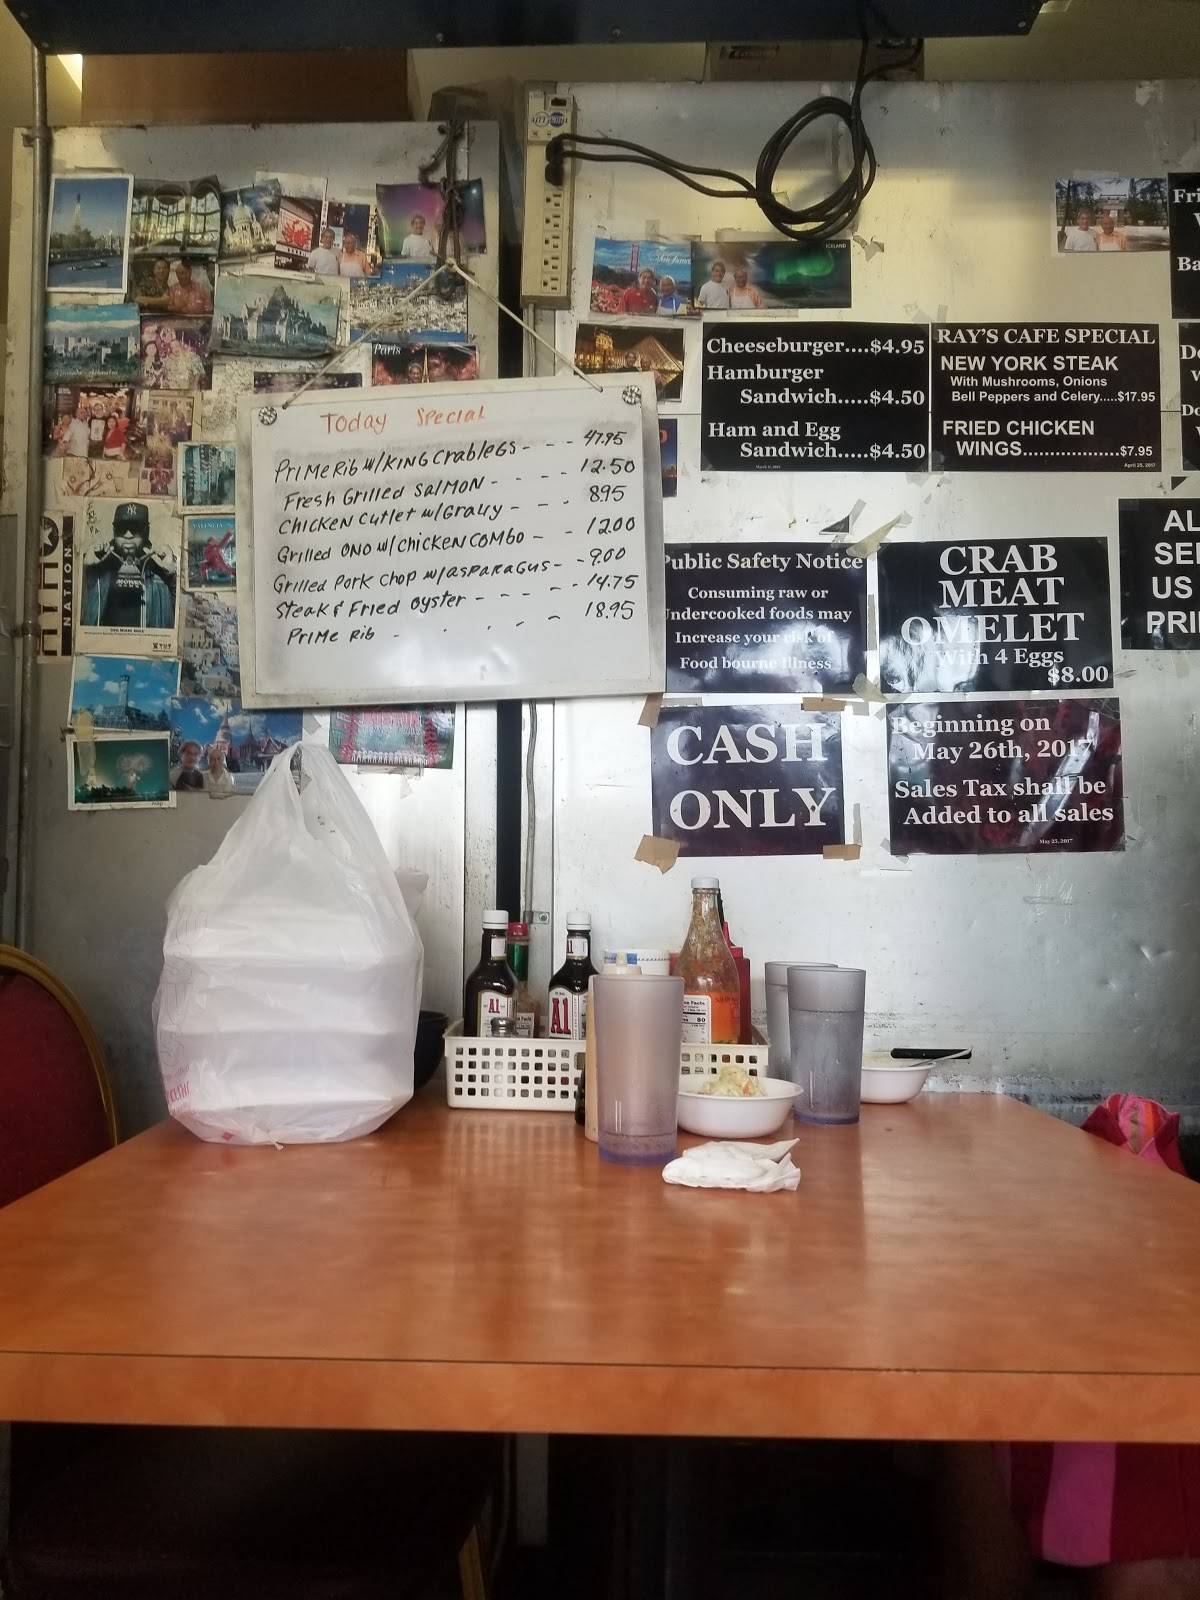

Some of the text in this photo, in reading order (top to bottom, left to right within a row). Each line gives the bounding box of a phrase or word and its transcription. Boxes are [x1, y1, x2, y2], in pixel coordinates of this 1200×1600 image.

[1003, 328, 1060, 344] CAFE
[1064, 328, 1156, 345] SPECIAL
[373, 343, 401, 356] Paris
[706, 363, 825, 383] Hamburger
[941, 355, 1119, 371] NEW YORK STEAK
[950, 375, 1108, 388] With Mushrooms, Onions
[952, 390, 976, 402] Bell
[979, 391, 1030, 404] Peppers
[1033, 390, 1057, 402] and
[320, 411, 387, 435] Today
[708, 420, 842, 441] Ham and Egg
[942, 420, 1095, 436] FRIED CHICKEN
[283, 490, 335, 512] Fresh
[580, 457, 636, 475] 12.50
[586, 516, 636, 535] 12.00
[589, 547, 626, 567] 9.00
[727, 552, 791, 572] Safety
[795, 552, 864, 569] Notice
[939, 544, 1058, 576] CRAB
[1154, 541, 1200, 565] SE
[63, 547, 73, 627] NATION
[587, 572, 639, 592] 14.75
[938, 576, 1065, 609] MEAT
[1152, 575, 1193, 599] US
[688, 586, 829, 601] Consuming raw or
[585, 599, 636, 620] 18.95
[769, 606, 814, 620] foods
[818, 610, 852, 623] may
[901, 612, 1085, 646] OMELET
[1146, 610, 1200, 634] PRI
[675, 631, 741, 643] Increase
[745, 634, 779, 646] your
[680, 656, 718, 669] Food
[994, 649, 1008, 664] 4
[1014, 648, 1065, 668] Eggs
[1047, 665, 1109, 686] $8.00
[890, 714, 1051, 737] Beginning on
[666, 722, 828, 766] CASH
[912, 739, 1094, 764] May 26th, 2017
[894, 776, 1107, 799] Sales Tax shall be
[669, 788, 837, 830] ONLY
[903, 803, 1114, 825] Added to all sales
